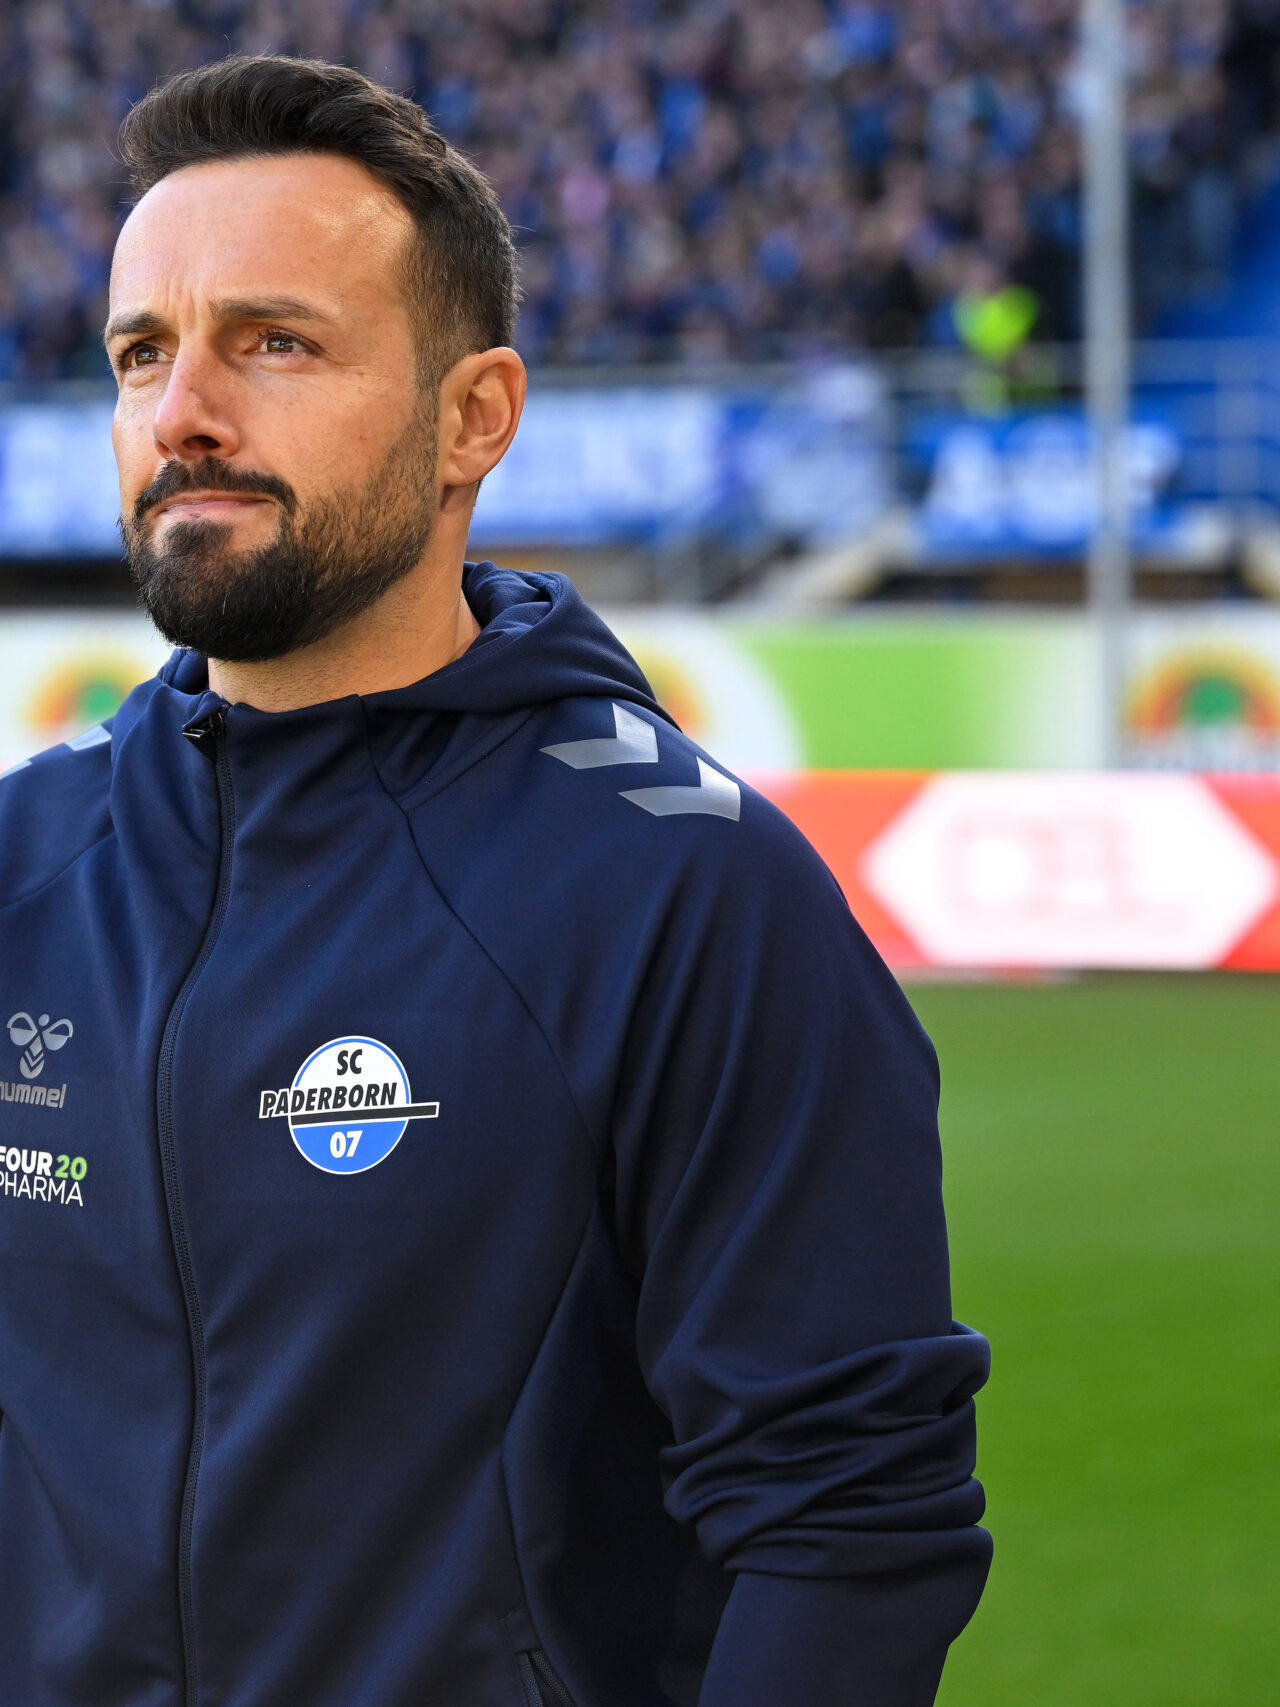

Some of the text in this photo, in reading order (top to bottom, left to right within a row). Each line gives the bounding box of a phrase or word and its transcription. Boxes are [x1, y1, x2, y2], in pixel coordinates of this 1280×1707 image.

[336, 1048, 363, 1076] SC
[262, 1082, 398, 1117] PADERBORN
[329, 1130, 363, 1159] 07
[55, 1154, 88, 1181] 20
